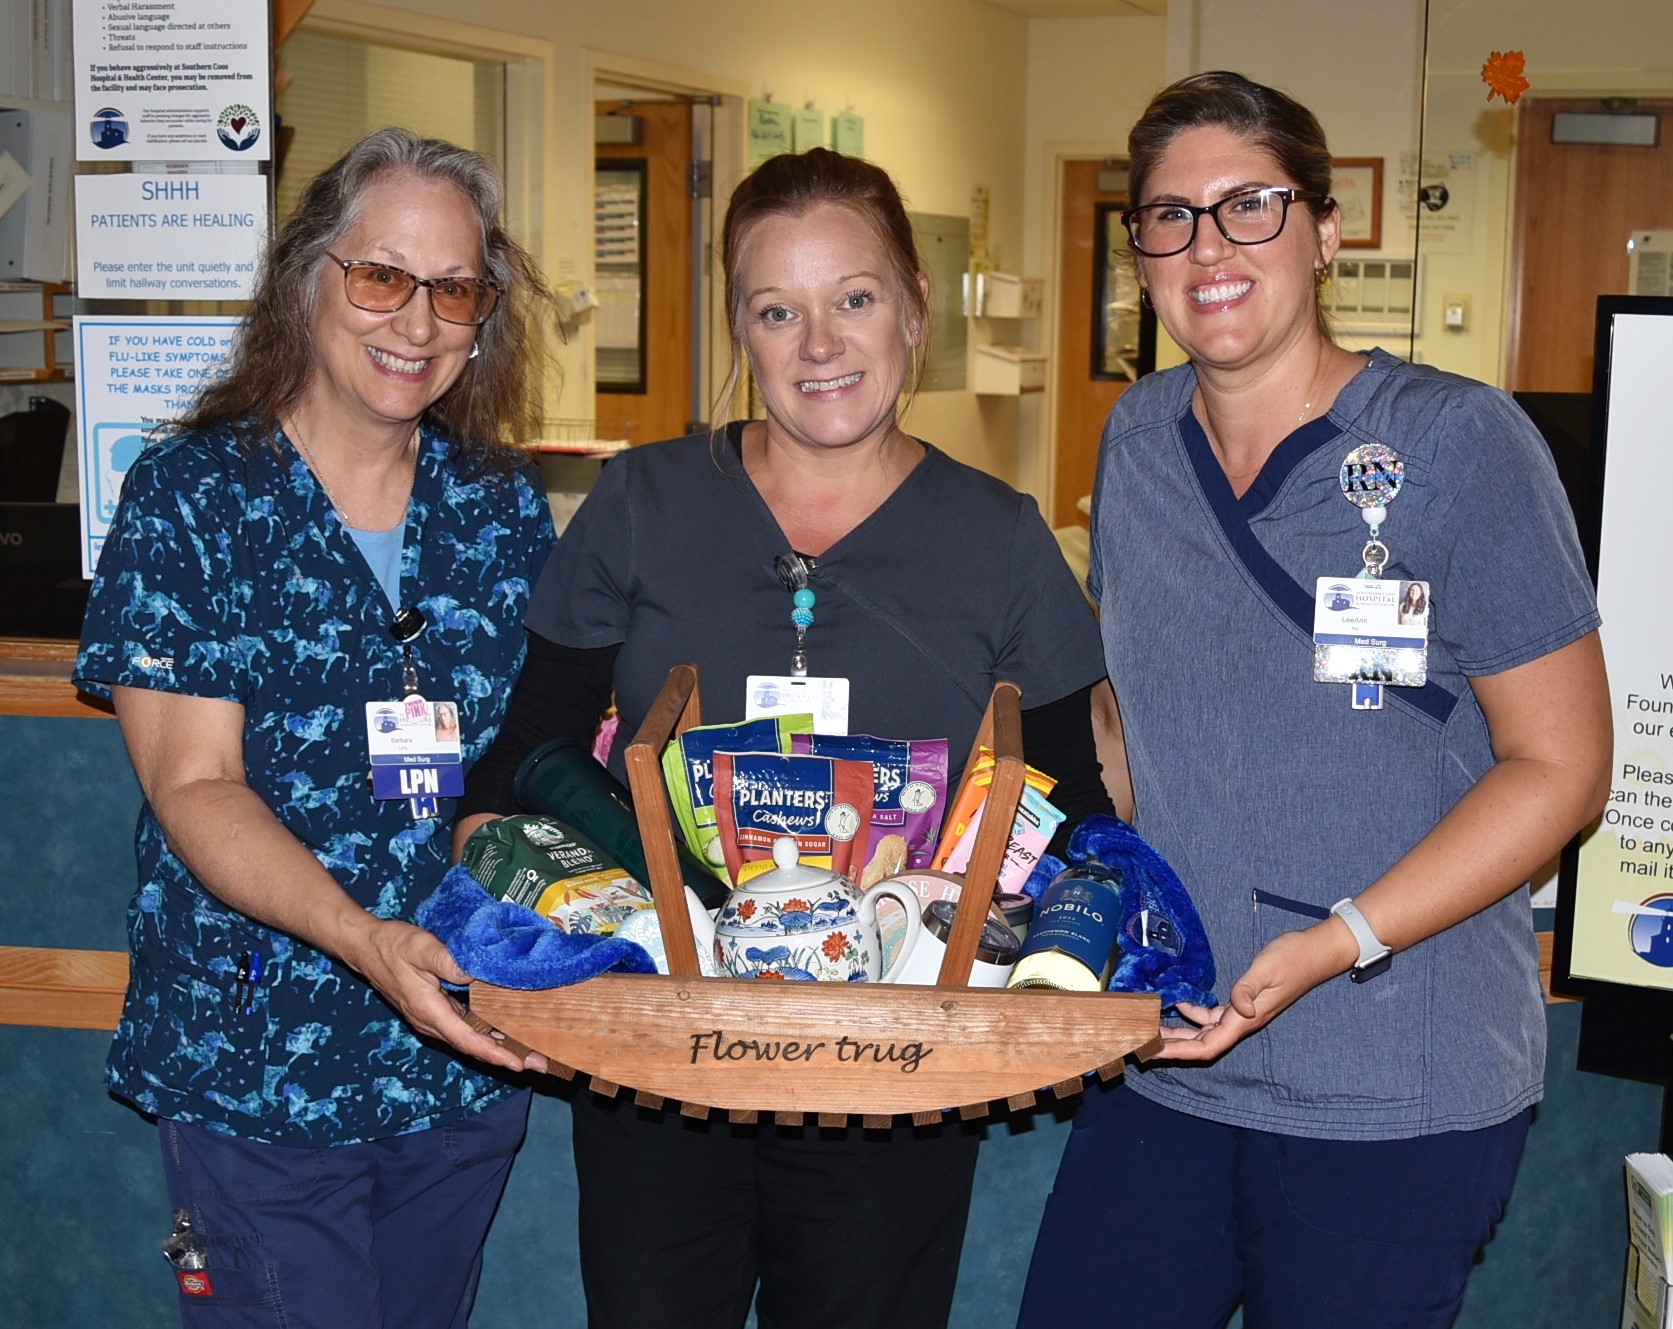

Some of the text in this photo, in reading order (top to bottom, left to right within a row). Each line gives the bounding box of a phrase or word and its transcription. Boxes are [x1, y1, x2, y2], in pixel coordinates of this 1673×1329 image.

[107, 2, 175, 10] Verbal Harassment
[108, 13, 170, 22] Abusive language
[108, 23, 131, 31] Sexual
[132, 23, 165, 33] language
[167, 22, 197, 30] directed
[207, 22, 231, 30] others
[108, 33, 135, 41] Threats
[108, 43, 135, 51] Refusal
[145, 43, 175, 52] respond
[185, 42, 202, 50] staff
[203, 42, 247, 50] instructions
[96, 65, 108, 73] you
[132, 64, 172, 73] aggressively
[90, 74, 117, 83] Hospital
[146, 74, 169, 82] Center,
[184, 74, 197, 82] may
[198, 73, 206, 81] be
[207, 73, 236, 81] removed
[90, 84, 101, 92] the
[102, 84, 125, 93] facility
[138, 84, 152, 92] may
[152, 83, 167, 91] face
[168, 83, 208, 92] prosecution.
[142, 180, 200, 201] SHHH
[91, 213, 254, 228] PATIENTS ARE HEALING
[93, 261, 254, 274] Please enter the unit quietly and
[106, 278, 241, 290] limit hallway conversations.
[108, 335, 121, 346] IF
[124, 335, 148, 346] YOU
[152, 335, 182, 346] HAVE
[186, 335, 216, 346] COLD
[109, 351, 227, 362] FLU-LIKE SYMPTOMS
[110, 367, 150, 379] PLEASE
[155, 367, 184, 379] TAKE
[187, 368, 211, 379] ONE
[106, 384, 128, 394] THE
[133, 383, 171, 394] MASKS
[141, 415, 154, 423] You
[1344, 460, 1399, 493] RN
[1355, 595, 1396, 603] HOSPITAL
[1341, 616, 1368, 624] LeeAnn
[1354, 637, 1387, 647] Med Surg
[131, 656, 175, 670] FORCE
[404, 703, 428, 720] PINK
[1633, 721, 1664, 737] our
[417, 756, 431, 764] Surg
[399, 768, 439, 795] LPN
[739, 788, 826, 810] PLANTERS
[1608, 789, 1637, 804] can
[752, 808, 815, 827] Cashews
[1605, 808, 1654, 830] Once
[739, 832, 772, 843] CINNAMON
[1619, 834, 1637, 851] to
[560, 855, 593, 869] BLEND
[1619, 860, 1658, 877] mail
[1039, 903, 1104, 923] NOBILO
[689, 1029, 934, 1074] Flower trug
